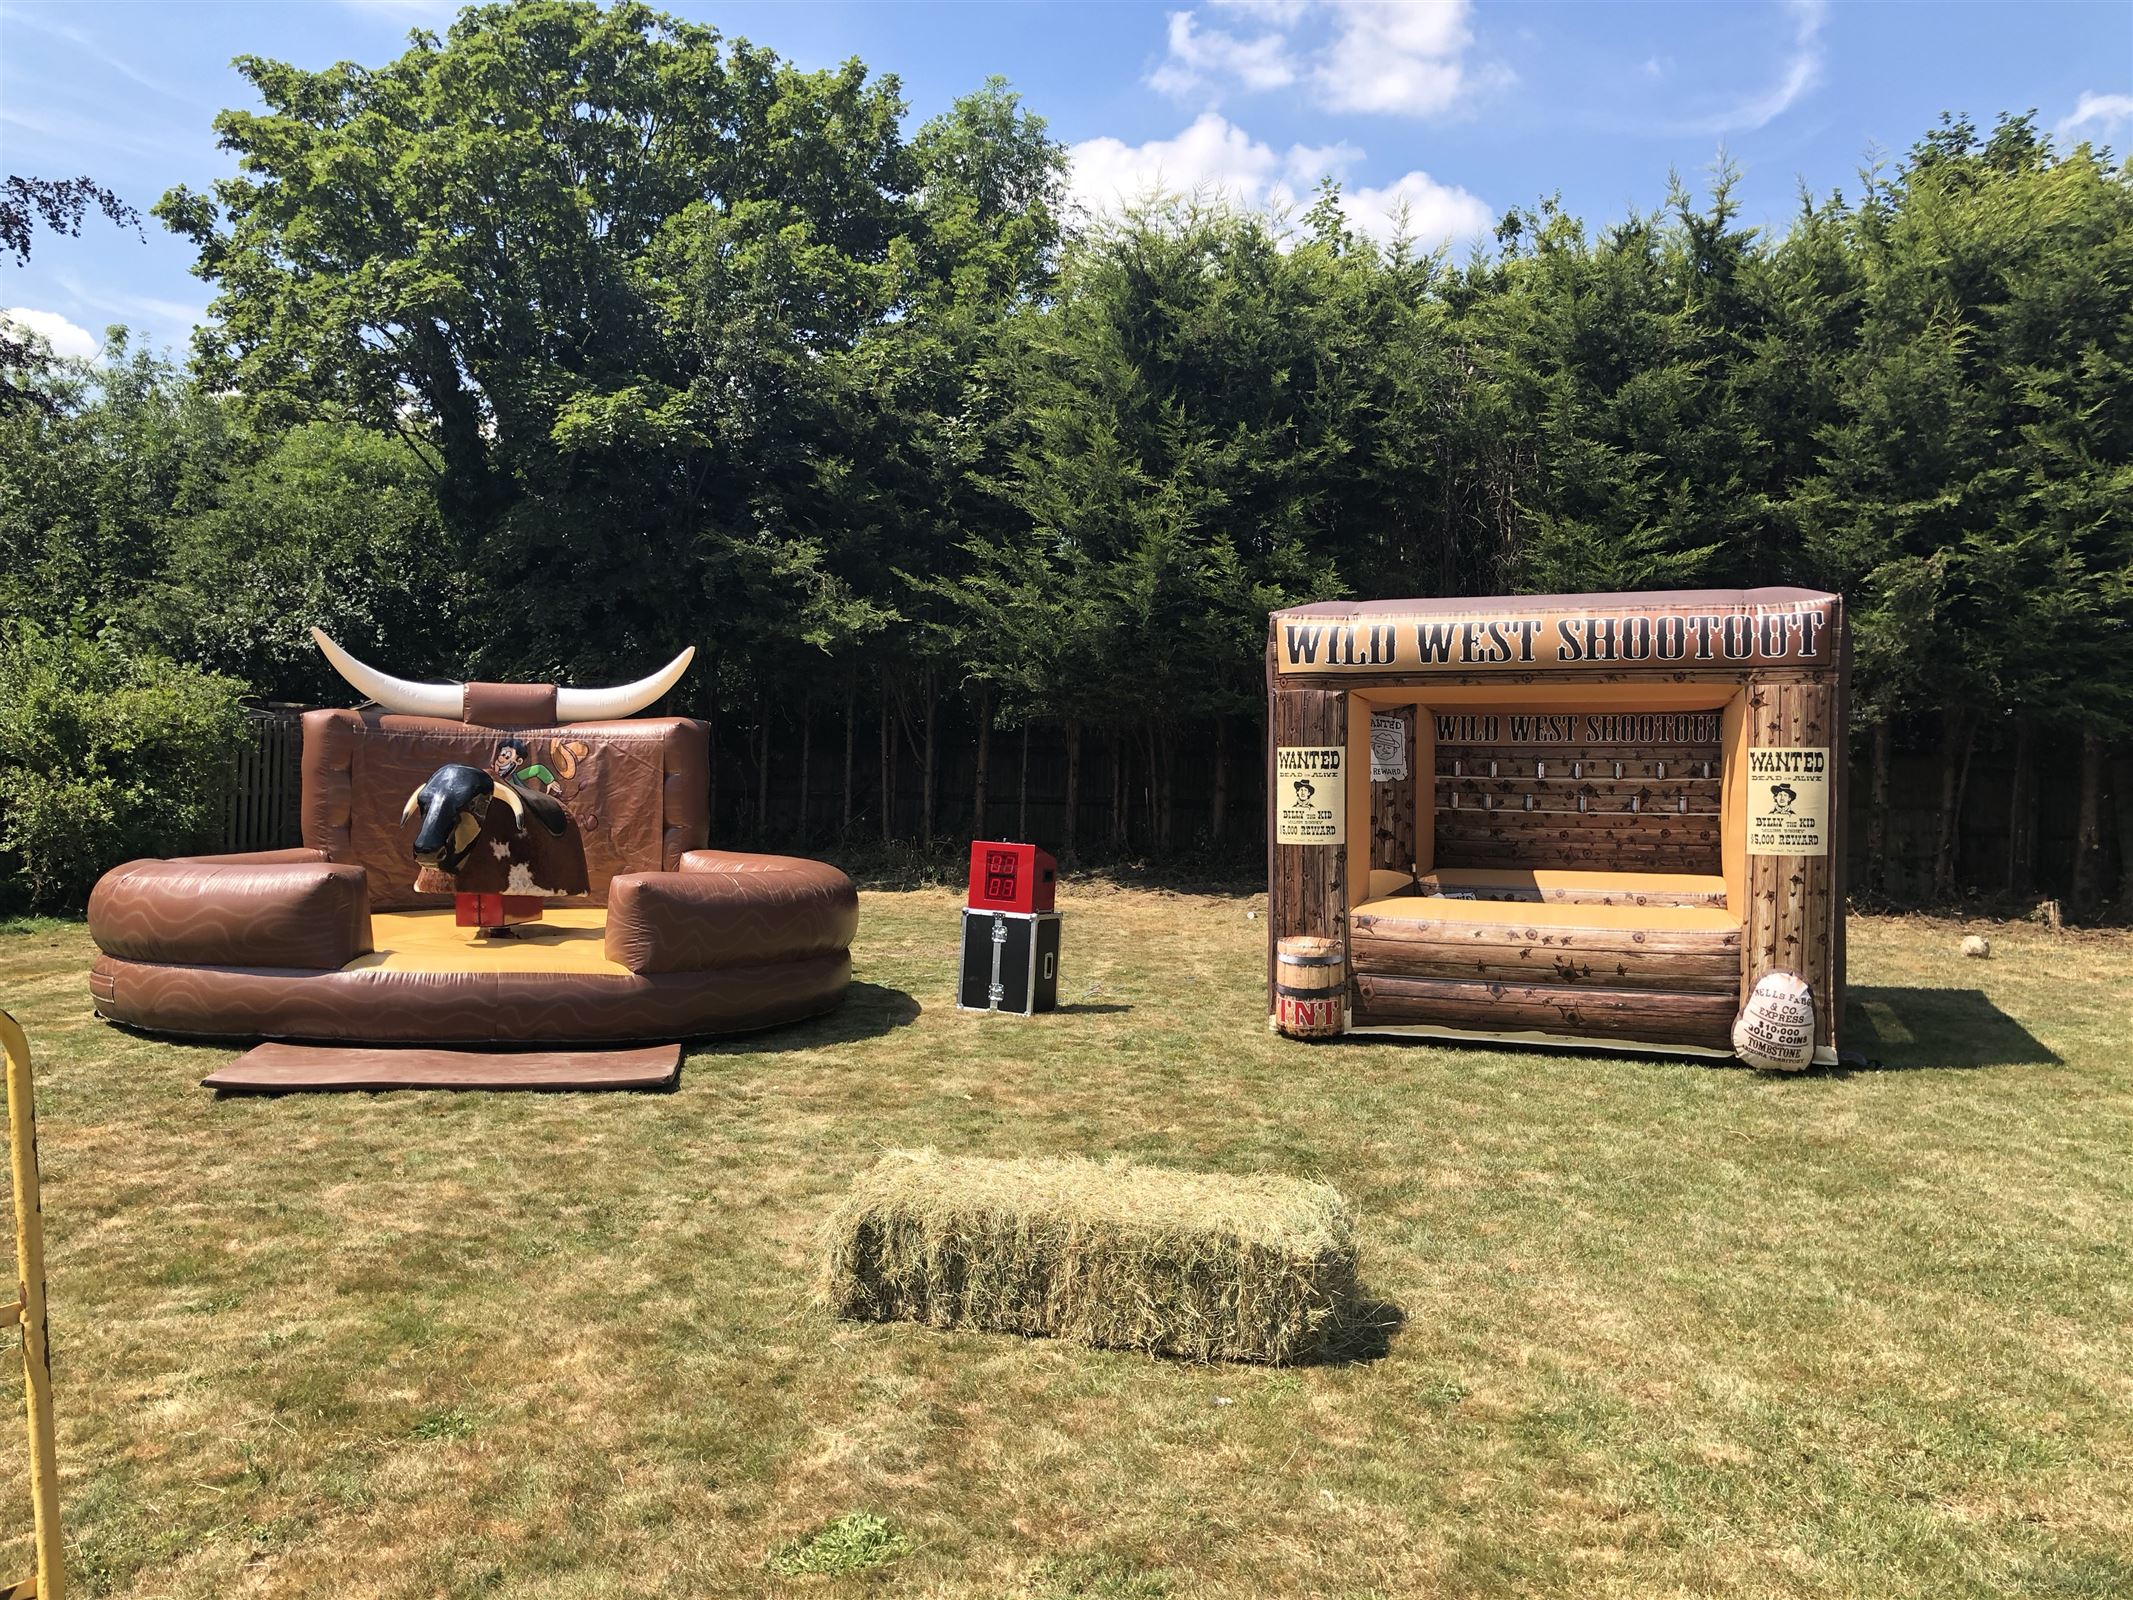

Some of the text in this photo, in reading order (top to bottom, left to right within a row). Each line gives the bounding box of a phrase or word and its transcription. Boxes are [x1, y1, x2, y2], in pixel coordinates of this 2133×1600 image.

[1284, 611, 1825, 666] WILD WEST SHOOTOUT
[1370, 719, 1402, 729] ANTED
[1435, 714, 1722, 743] WILD WEST SHOOTOUT
[1278, 751, 1340, 770] WANTED
[1750, 752, 1825, 772] WANTED
[1373, 767, 1401, 776] REWARD
[1283, 810, 1305, 819] BILLY
[1317, 810, 1332, 819] KID
[1756, 817, 1784, 827] BILLY
[1799, 818, 1816, 828] KID
[1300, 825, 1336, 836] REWARD
[1778, 834, 1819, 845] REWARD
[1278, 997, 1338, 1026] TNT
[1760, 1007, 1805, 1024] EXPRESS
[1770, 1002, 1799, 1015] & CO.
[1759, 1020, 1800, 1036] $10,000
[1748, 1036, 1802, 1058] TOMBSTONE
[1778, 1036, 1808, 1045] COINS
